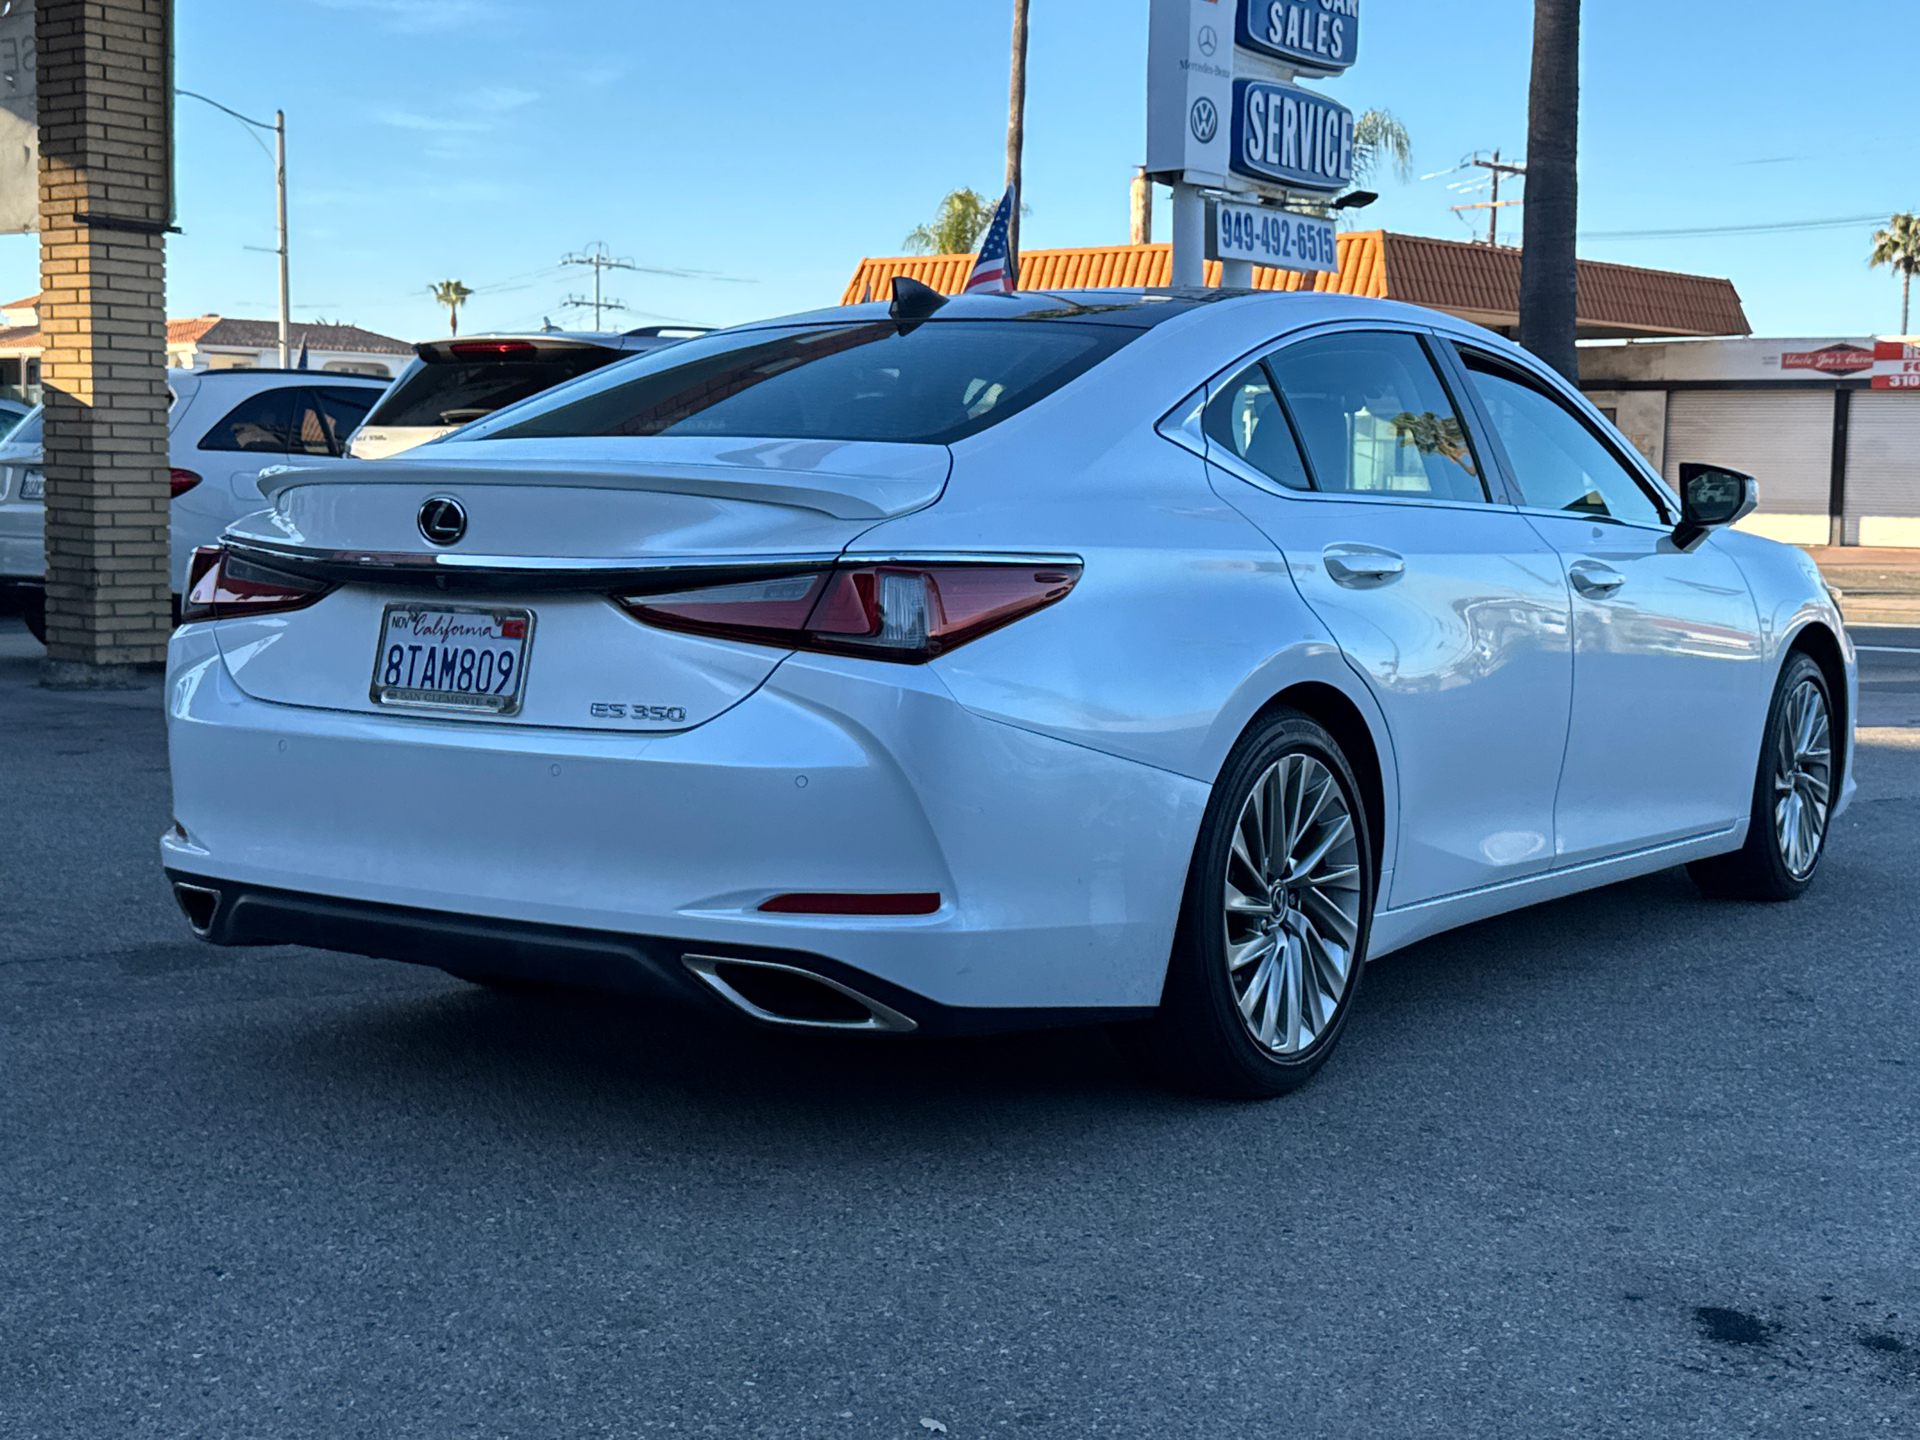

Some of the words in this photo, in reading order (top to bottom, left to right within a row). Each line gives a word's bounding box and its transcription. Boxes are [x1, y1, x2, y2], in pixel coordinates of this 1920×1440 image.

[1269, 1, 1344, 58] SALES
[1179, 59, 1231, 79] Mercedes-Benz
[1248, 90, 1351, 180] SERVICE
[1221, 209, 1334, 265] 949-492-6515
[1785, 354, 1813, 365] Uncle
[392, 616, 410, 629] NOV
[413, 613, 503, 643] California
[384, 644, 515, 694] 8TAM809
[401, 691, 421, 701] SAN
[425, 692, 483, 706] CLEMENTE
[590, 703, 627, 719] ES
[630, 704, 687, 722] 350
